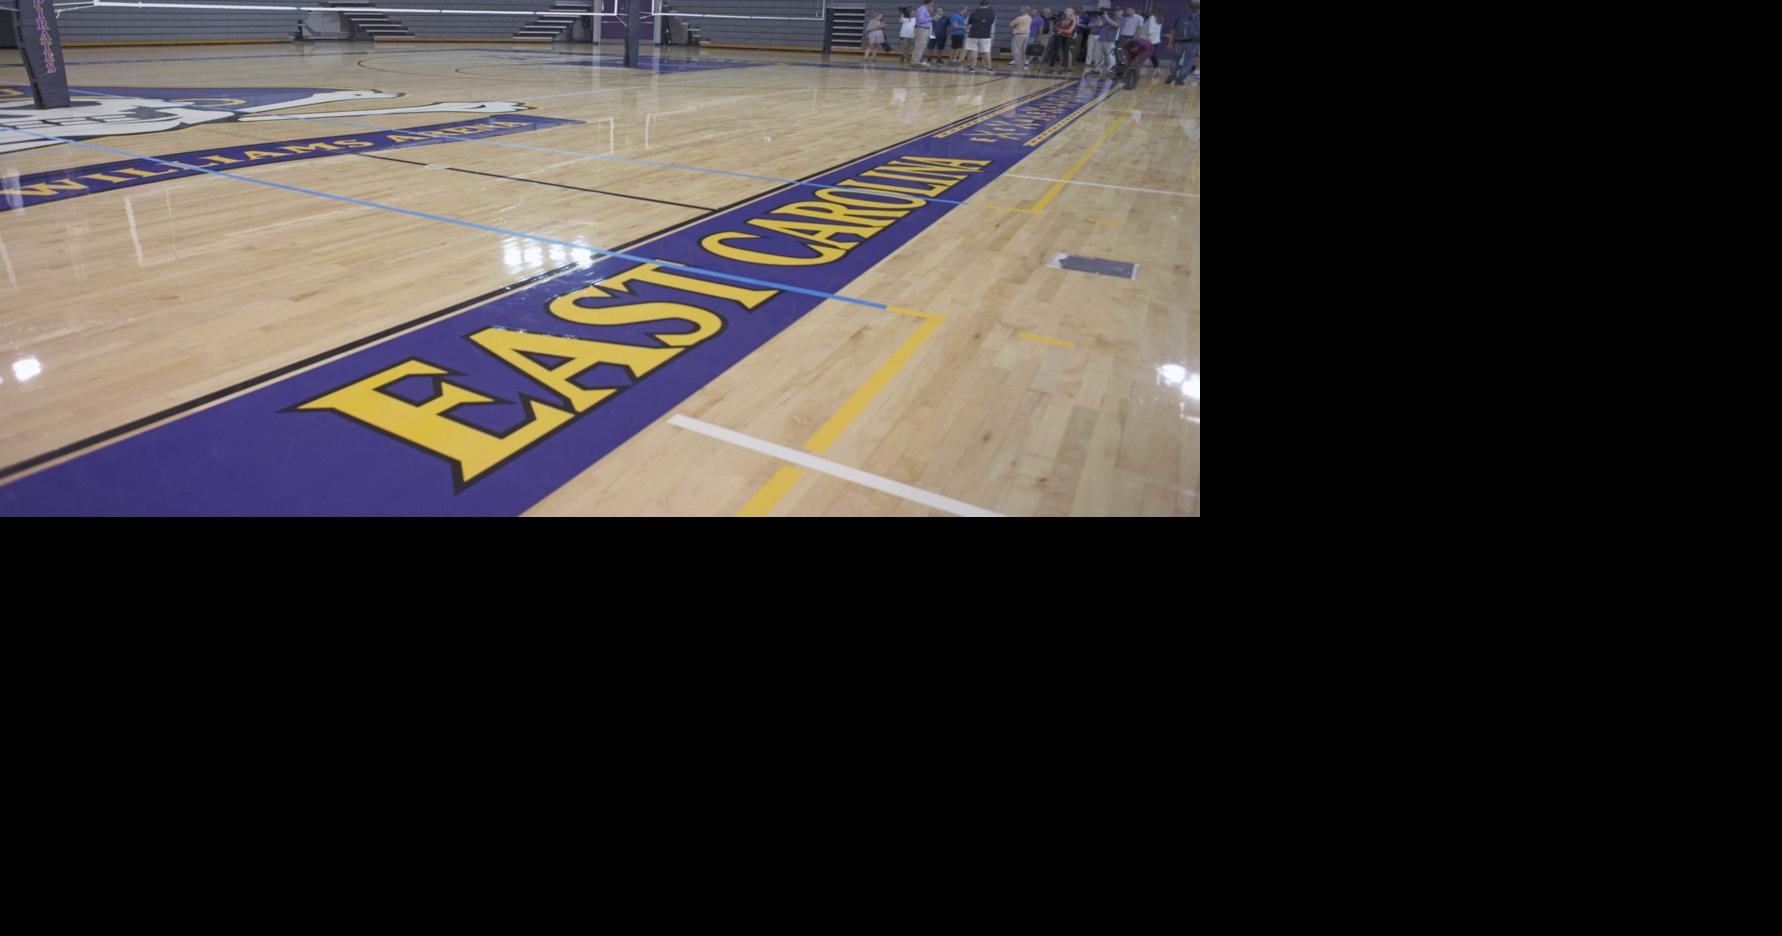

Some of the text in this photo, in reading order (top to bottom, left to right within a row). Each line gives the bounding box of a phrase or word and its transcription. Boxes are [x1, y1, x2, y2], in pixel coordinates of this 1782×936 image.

[0, 119, 532, 196] WILLIAMS ARENA
[276, 153, 992, 494] EAST CAROLINA
